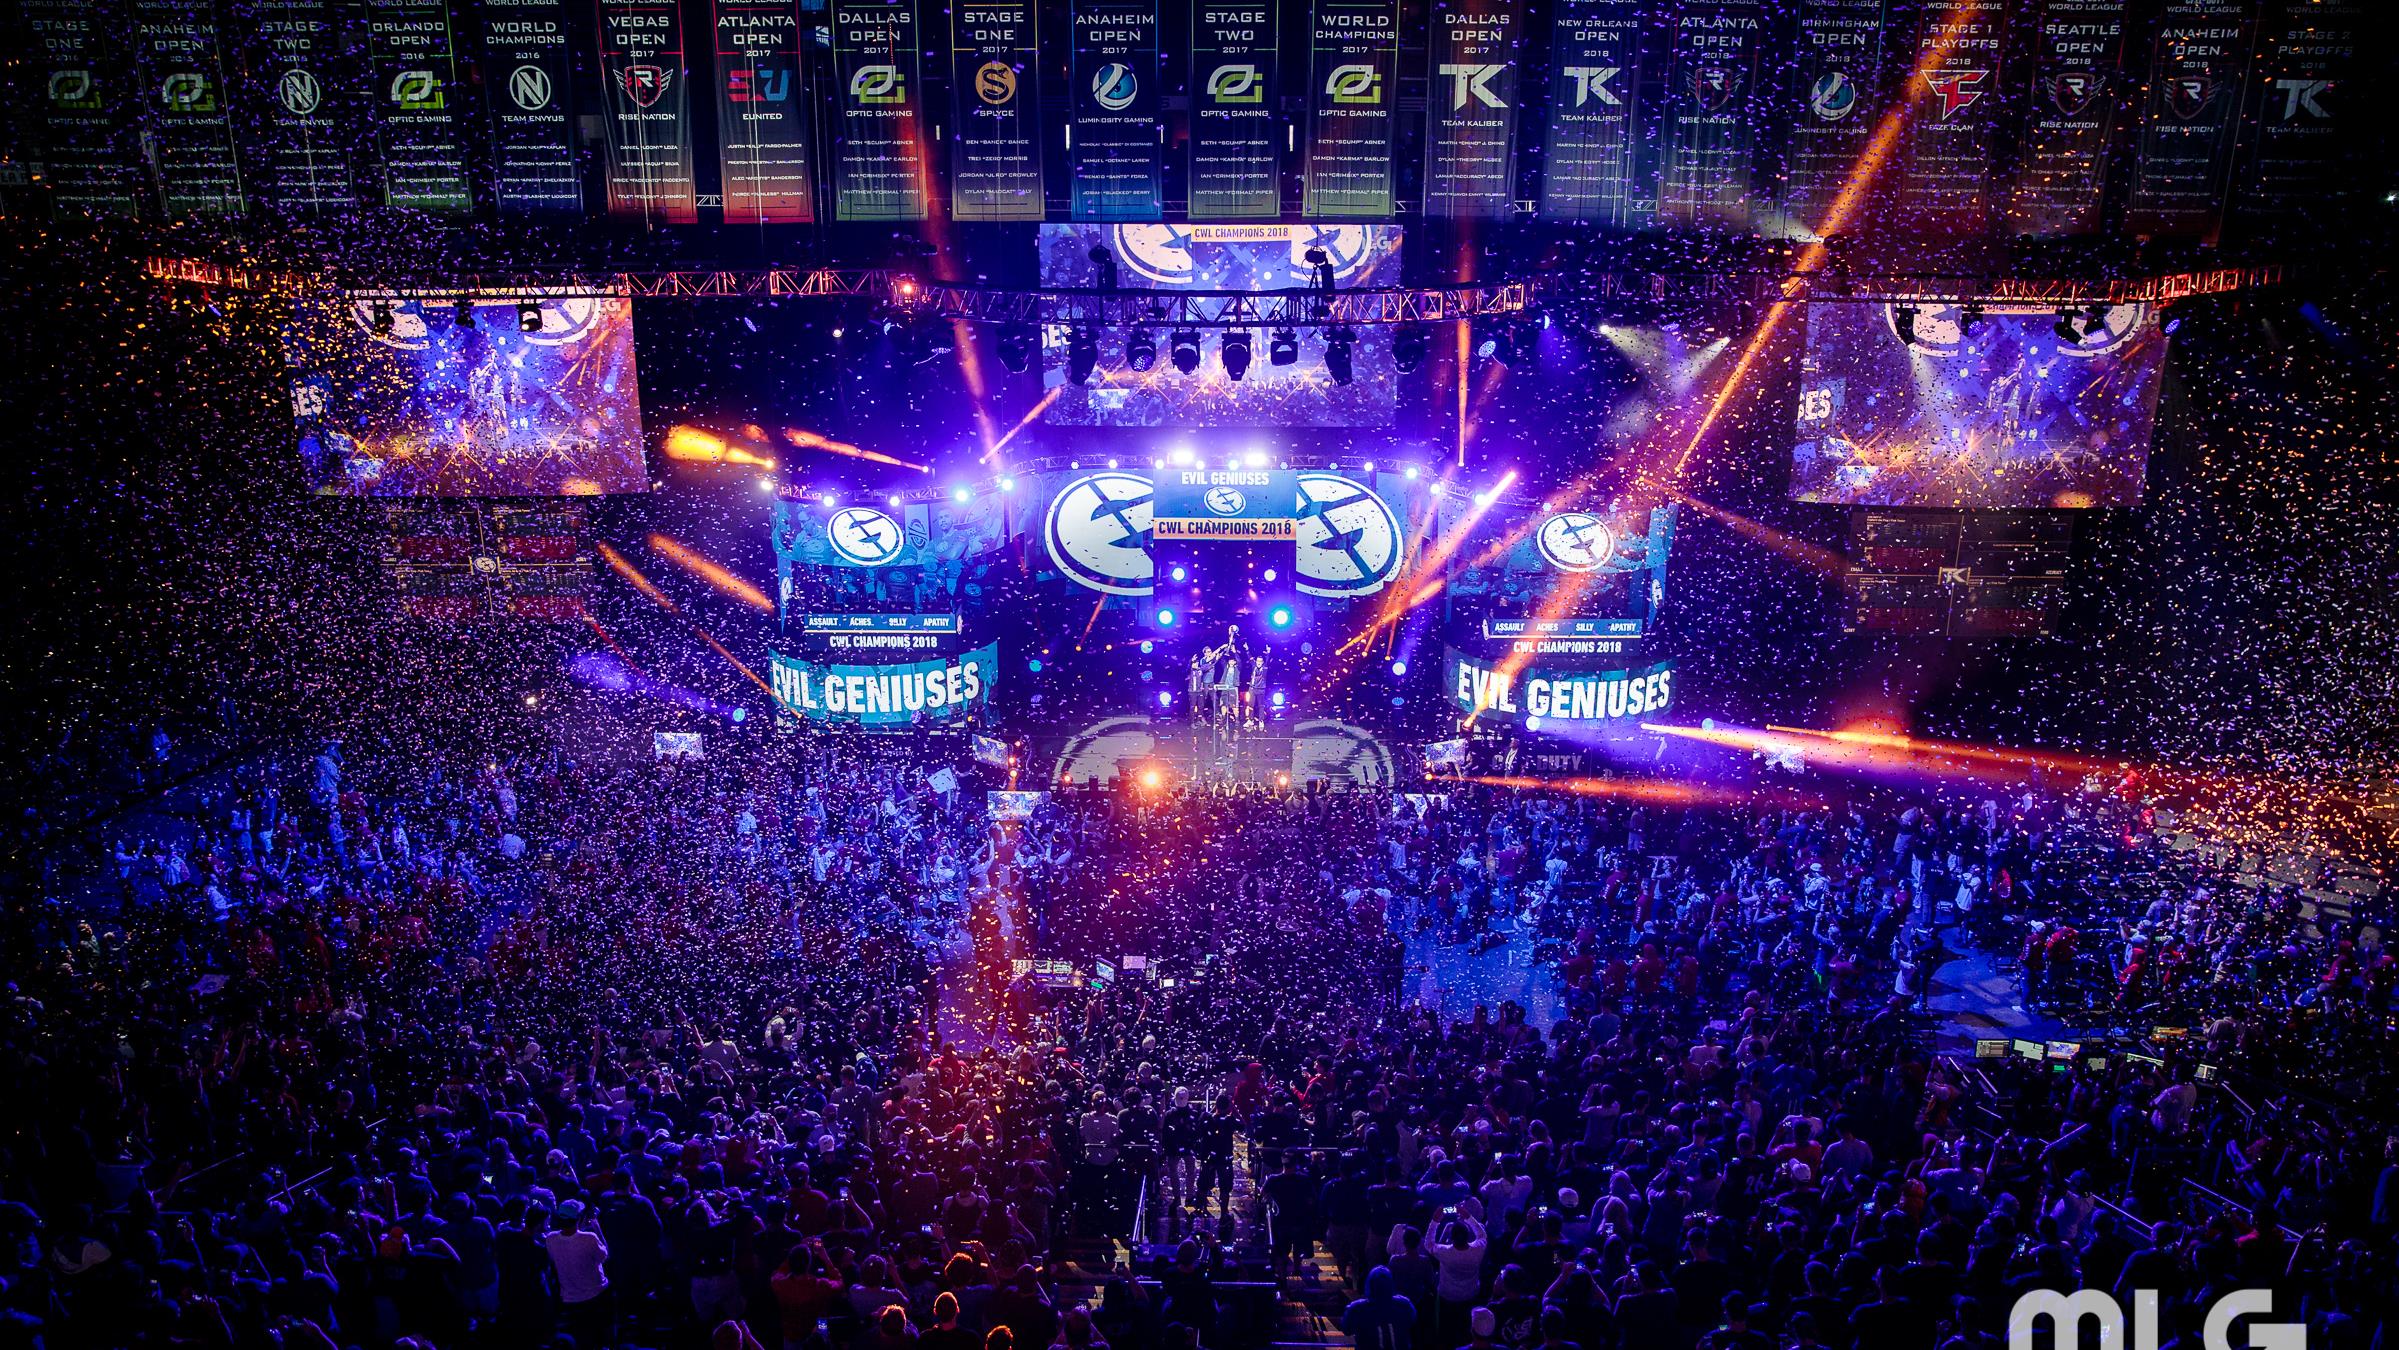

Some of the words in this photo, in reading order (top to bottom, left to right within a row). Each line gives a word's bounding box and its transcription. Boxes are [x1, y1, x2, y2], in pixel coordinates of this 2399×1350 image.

[1928, 2, 1961, 10] WORLD
[2049, 3, 2082, 11] WORLD
[2086, 3, 2124, 11] LEAGUE
[609, 16, 669, 27] VEGAS
[718, 16, 796, 27] ATLANTA
[839, 13, 910, 23] DALLAS
[964, 12, 1024, 22] STAGE
[1076, 15, 1154, 25] ANAHEIM
[1206, 13, 1265, 23] STAGE
[1322, 16, 1389, 26] WORLD
[1446, 14, 1510, 24] DALLAS
[32, 21, 89, 31] STAGE
[264, 22, 319, 32] STAGE
[373, 23, 445, 31] ORLANDO
[492, 22, 557, 33] WORLD
[1586, 20, 1638, 28] ORLEANS
[1680, 18, 1758, 29] ATLANTA
[1802, 20, 1879, 28] BIRMINGHAM
[139, 25, 214, 34] ANAHEIM
[1930, 24, 1978, 34] STAGE
[1988, 25, 1992, 33] 1
[2045, 24, 2120, 36] SEATTLE
[2162, 29, 2239, 39] ANAHEIM
[486, 36, 565, 44] CHAMPIONS
[617, 34, 666, 45] OPEN
[734, 34, 782, 44] OPEN
[850, 31, 900, 41] OPEN
[975, 30, 1014, 40] ONE
[1090, 31, 1141, 41] OPEN
[1215, 31, 1254, 40] TWO
[1316, 31, 1395, 39] CHAMPIONS
[1451, 31, 1502, 41] OPEN
[1575, 32, 1619, 41] OPEN
[1813, 33, 1866, 45] OPEN
[2288, 31, 2331, 39] STAGE
[46, 39, 84, 48] ONE
[155, 40, 203, 50] OPEN
[391, 36, 430, 45] OPEN
[1693, 36, 1742, 47] OPEN
[1922, 39, 1998, 48] PLAYOFFS
[2056, 43, 2104, 53] OPEN
[2175, 46, 2220, 55] OPEN
[2278, 46, 2353, 55] PLAYOFFS
[1195, 228, 1211, 238] CWL
[1215, 227, 1264, 238] CHAMPIONS
[1268, 227, 1288, 237] 2018
[1181, 472, 1207, 485] EVIL
[1211, 472, 1269, 486] GENIUSES
[1158, 522, 1184, 534] CWL
[1188, 522, 1257, 534] CHAMPIONS
[1262, 522, 1291, 534] 2018
[809, 618, 838, 626] ASSAULT
[850, 617, 872, 626] ACHES
[924, 618, 949, 626] APATHY
[1495, 623, 1524, 631] ASSAULT
[1536, 623, 1558, 631] ACHES
[1576, 623, 1594, 631] SILLY
[1610, 623, 1636, 631] APATHY
[830, 637, 851, 647] CWL
[853, 636, 910, 647] CHAMPIONS
[913, 637, 937, 647] 2018
[1514, 642, 1535, 652] CWL
[1537, 642, 1594, 652] CHAMPIONS
[1597, 642, 1621, 652] 2018
[772, 660, 817, 709] EVIL
[824, 662, 979, 712] GENIUSES
[1458, 663, 1516, 712] EVIL
[1527, 670, 1671, 718] GENIUSES
[1537, 755, 1582, 770] DUTY
